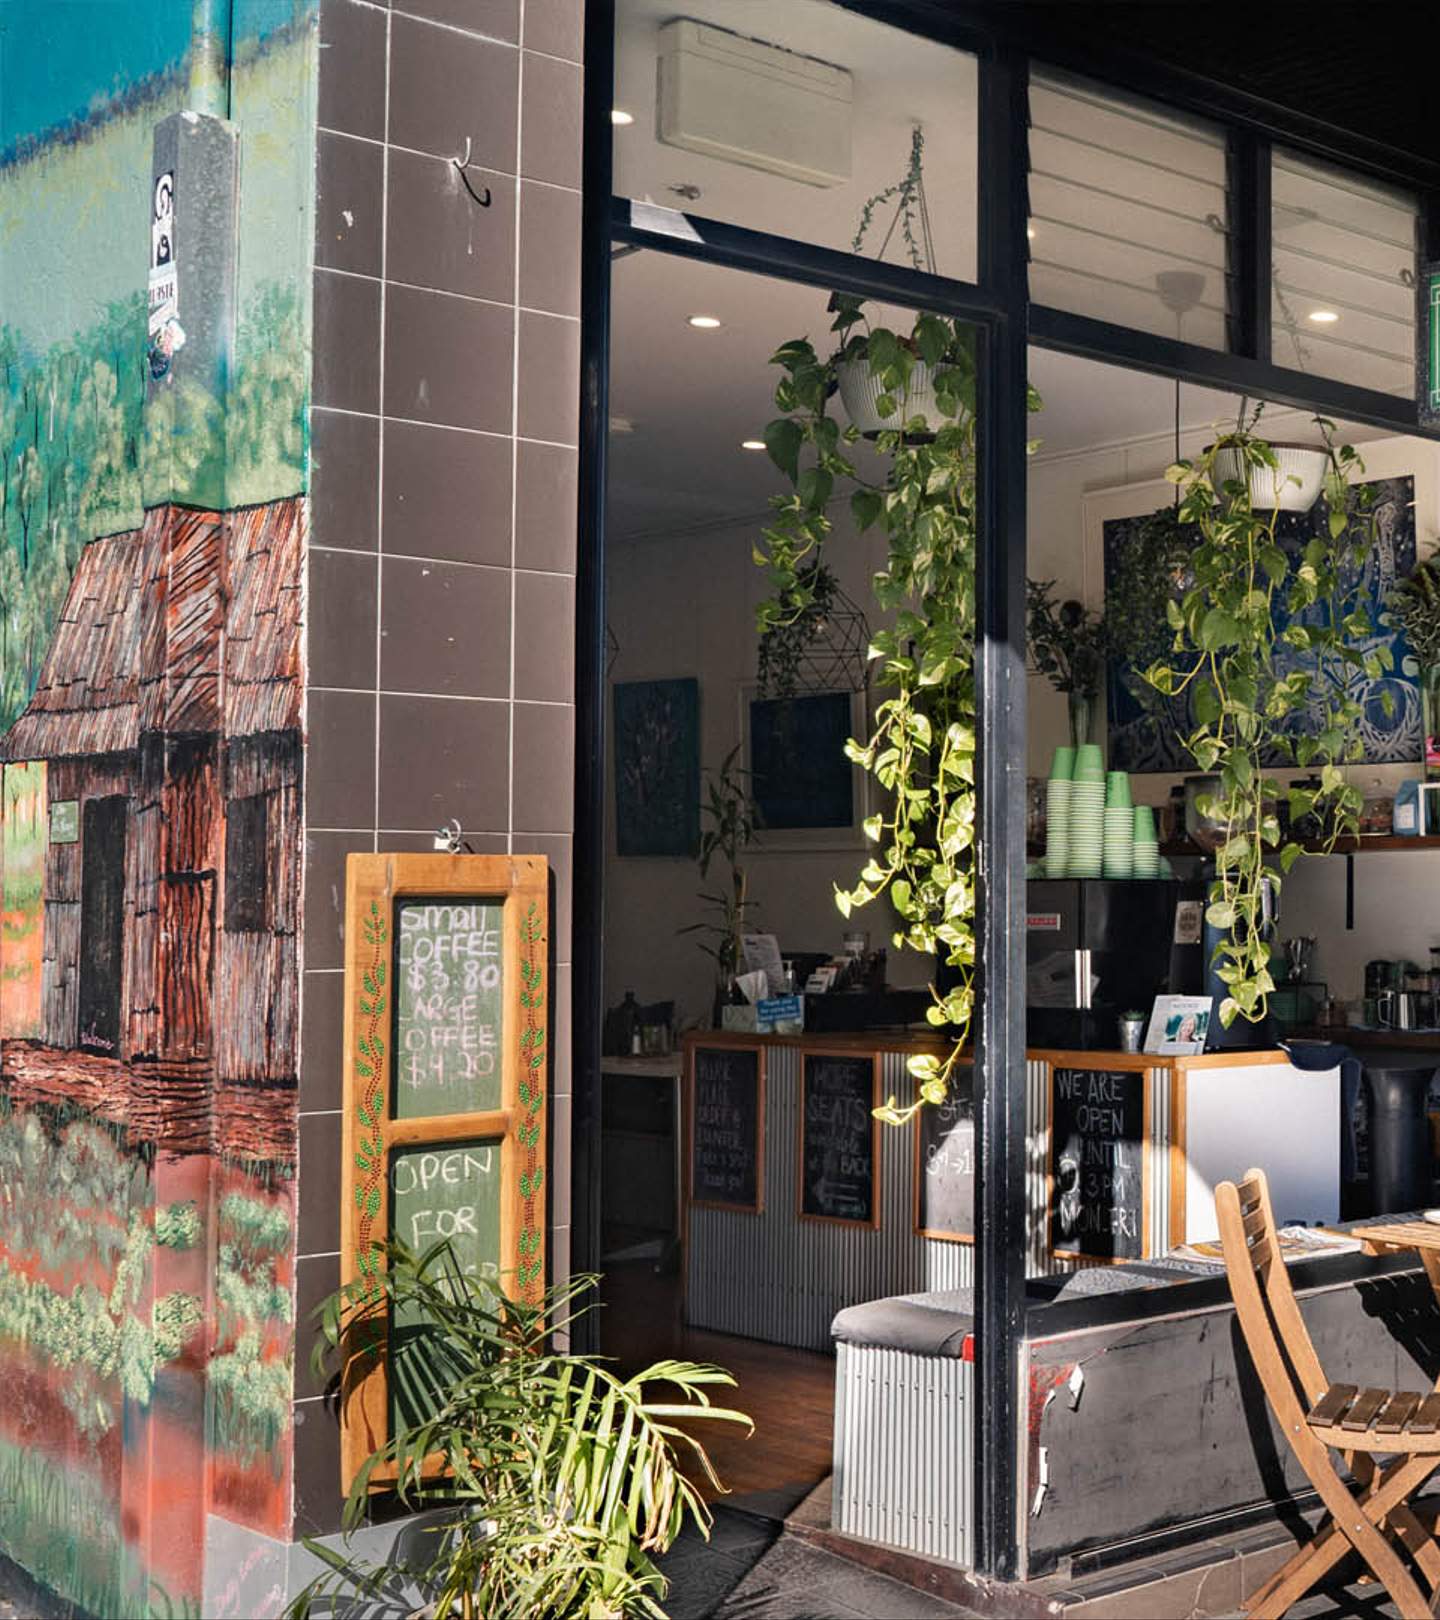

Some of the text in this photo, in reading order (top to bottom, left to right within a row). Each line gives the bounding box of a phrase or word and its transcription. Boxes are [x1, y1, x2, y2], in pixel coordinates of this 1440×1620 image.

[399, 1022, 498, 1053] OFFEE
[1057, 1070, 1127, 1104] WE ARE
[1076, 1104, 1125, 1136] OPEN
[391, 1147, 493, 1195] OPEN
[410, 1205, 480, 1249] FOR
